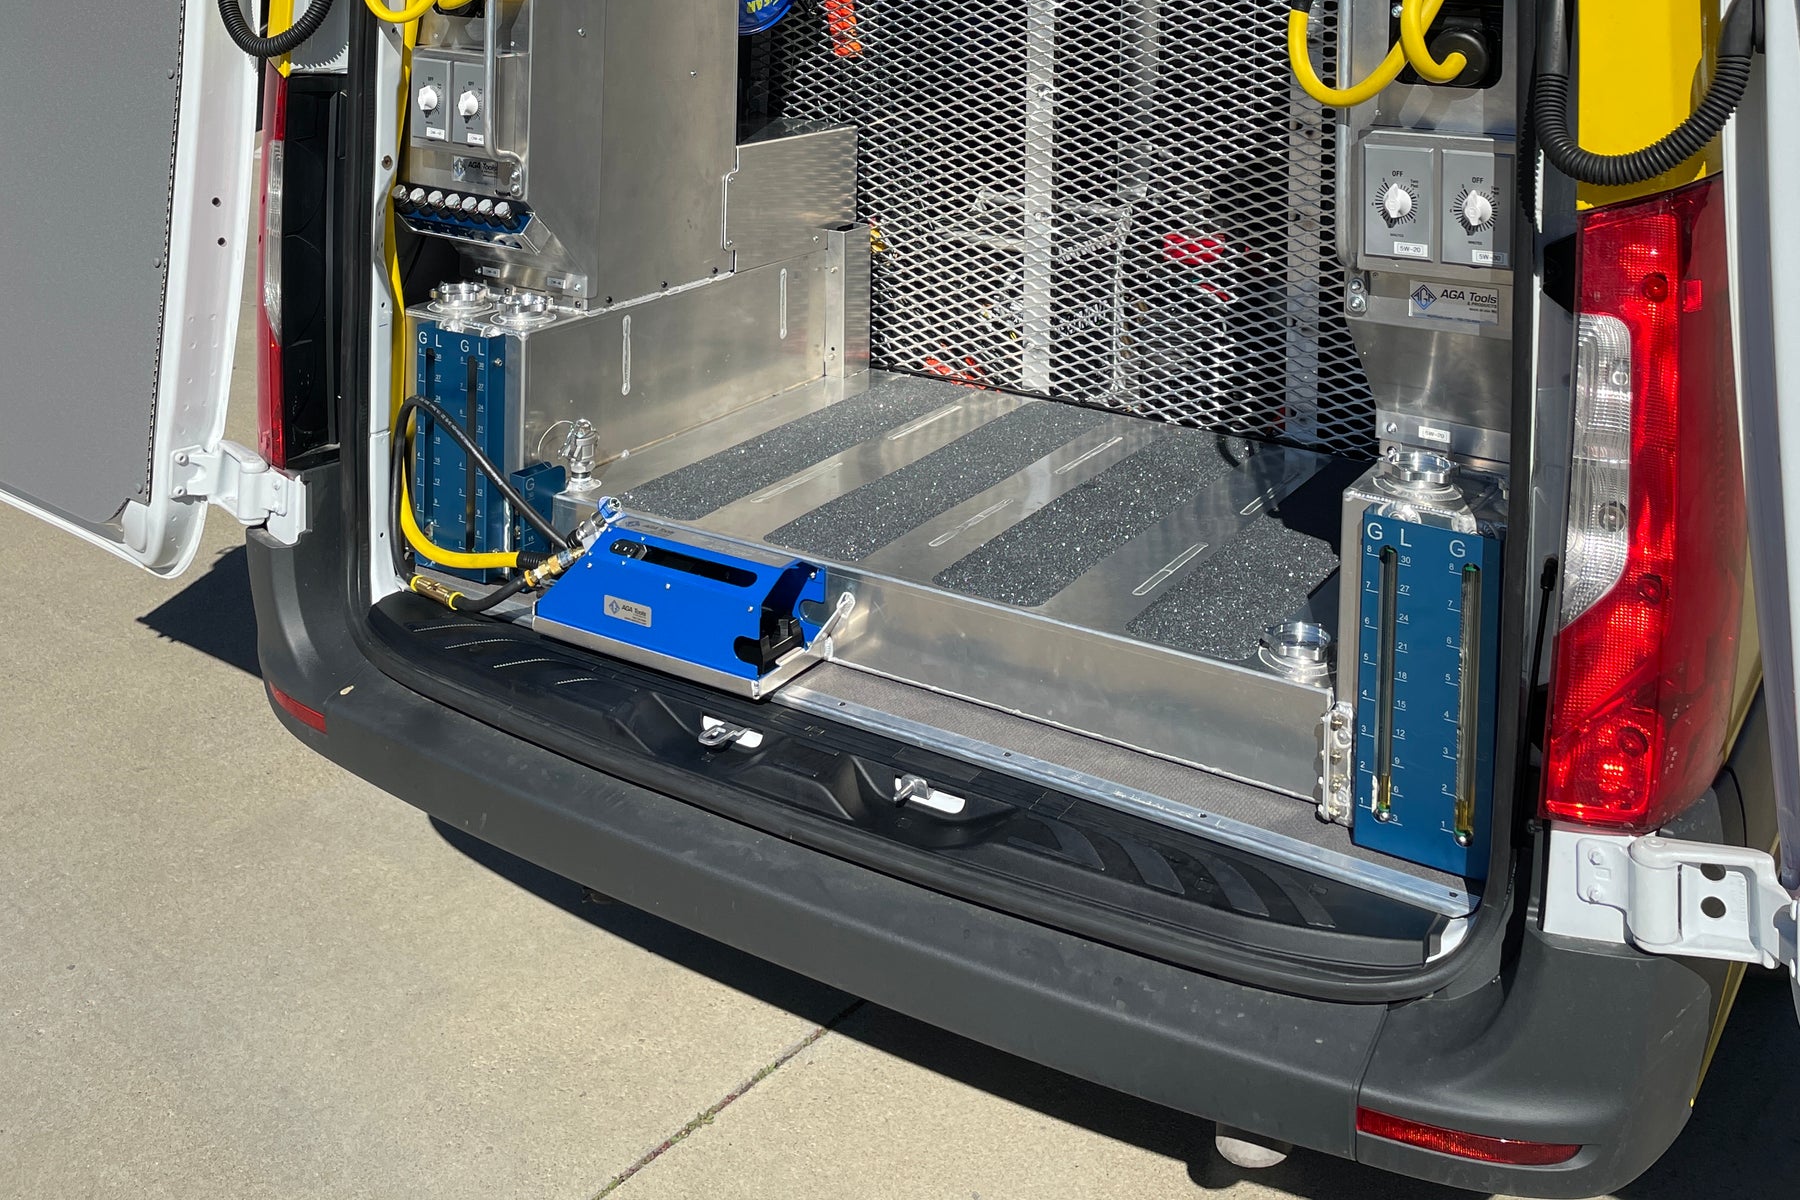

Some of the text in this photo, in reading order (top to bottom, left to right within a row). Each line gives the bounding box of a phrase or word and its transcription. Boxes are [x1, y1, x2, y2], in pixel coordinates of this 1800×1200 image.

[1440, 289, 1465, 300] AGA
[1469, 291, 1497, 304] Tools
[418, 331, 485, 356] G L G L
[525, 477, 535, 491] G
[1366, 522, 1466, 558] G L G
[1401, 556, 1411, 564] 30
[1449, 563, 1454, 571] 8
[1366, 581, 1371, 589] 7
[1400, 584, 1410, 593] 27
[1448, 599, 1453, 607] 7
[621, 604, 633, 613] AGA
[1364, 617, 1370, 625] 6
[1399, 614, 1409, 622] 24
[1446, 637, 1452, 645] 6
[1398, 642, 1407, 650] 21
[1363, 653, 1369, 661] 5
[1398, 671, 1407, 680] 18
[1362, 689, 1367, 697] 4
[1396, 700, 1406, 708] 15
[1443, 710, 1449, 718] 4
[1396, 729, 1406, 737] 12
[1442, 747, 1448, 755] 3
[1360, 761, 1365, 769] 2
[1394, 757, 1400, 765] 9
[1392, 814, 1398, 822] 3
